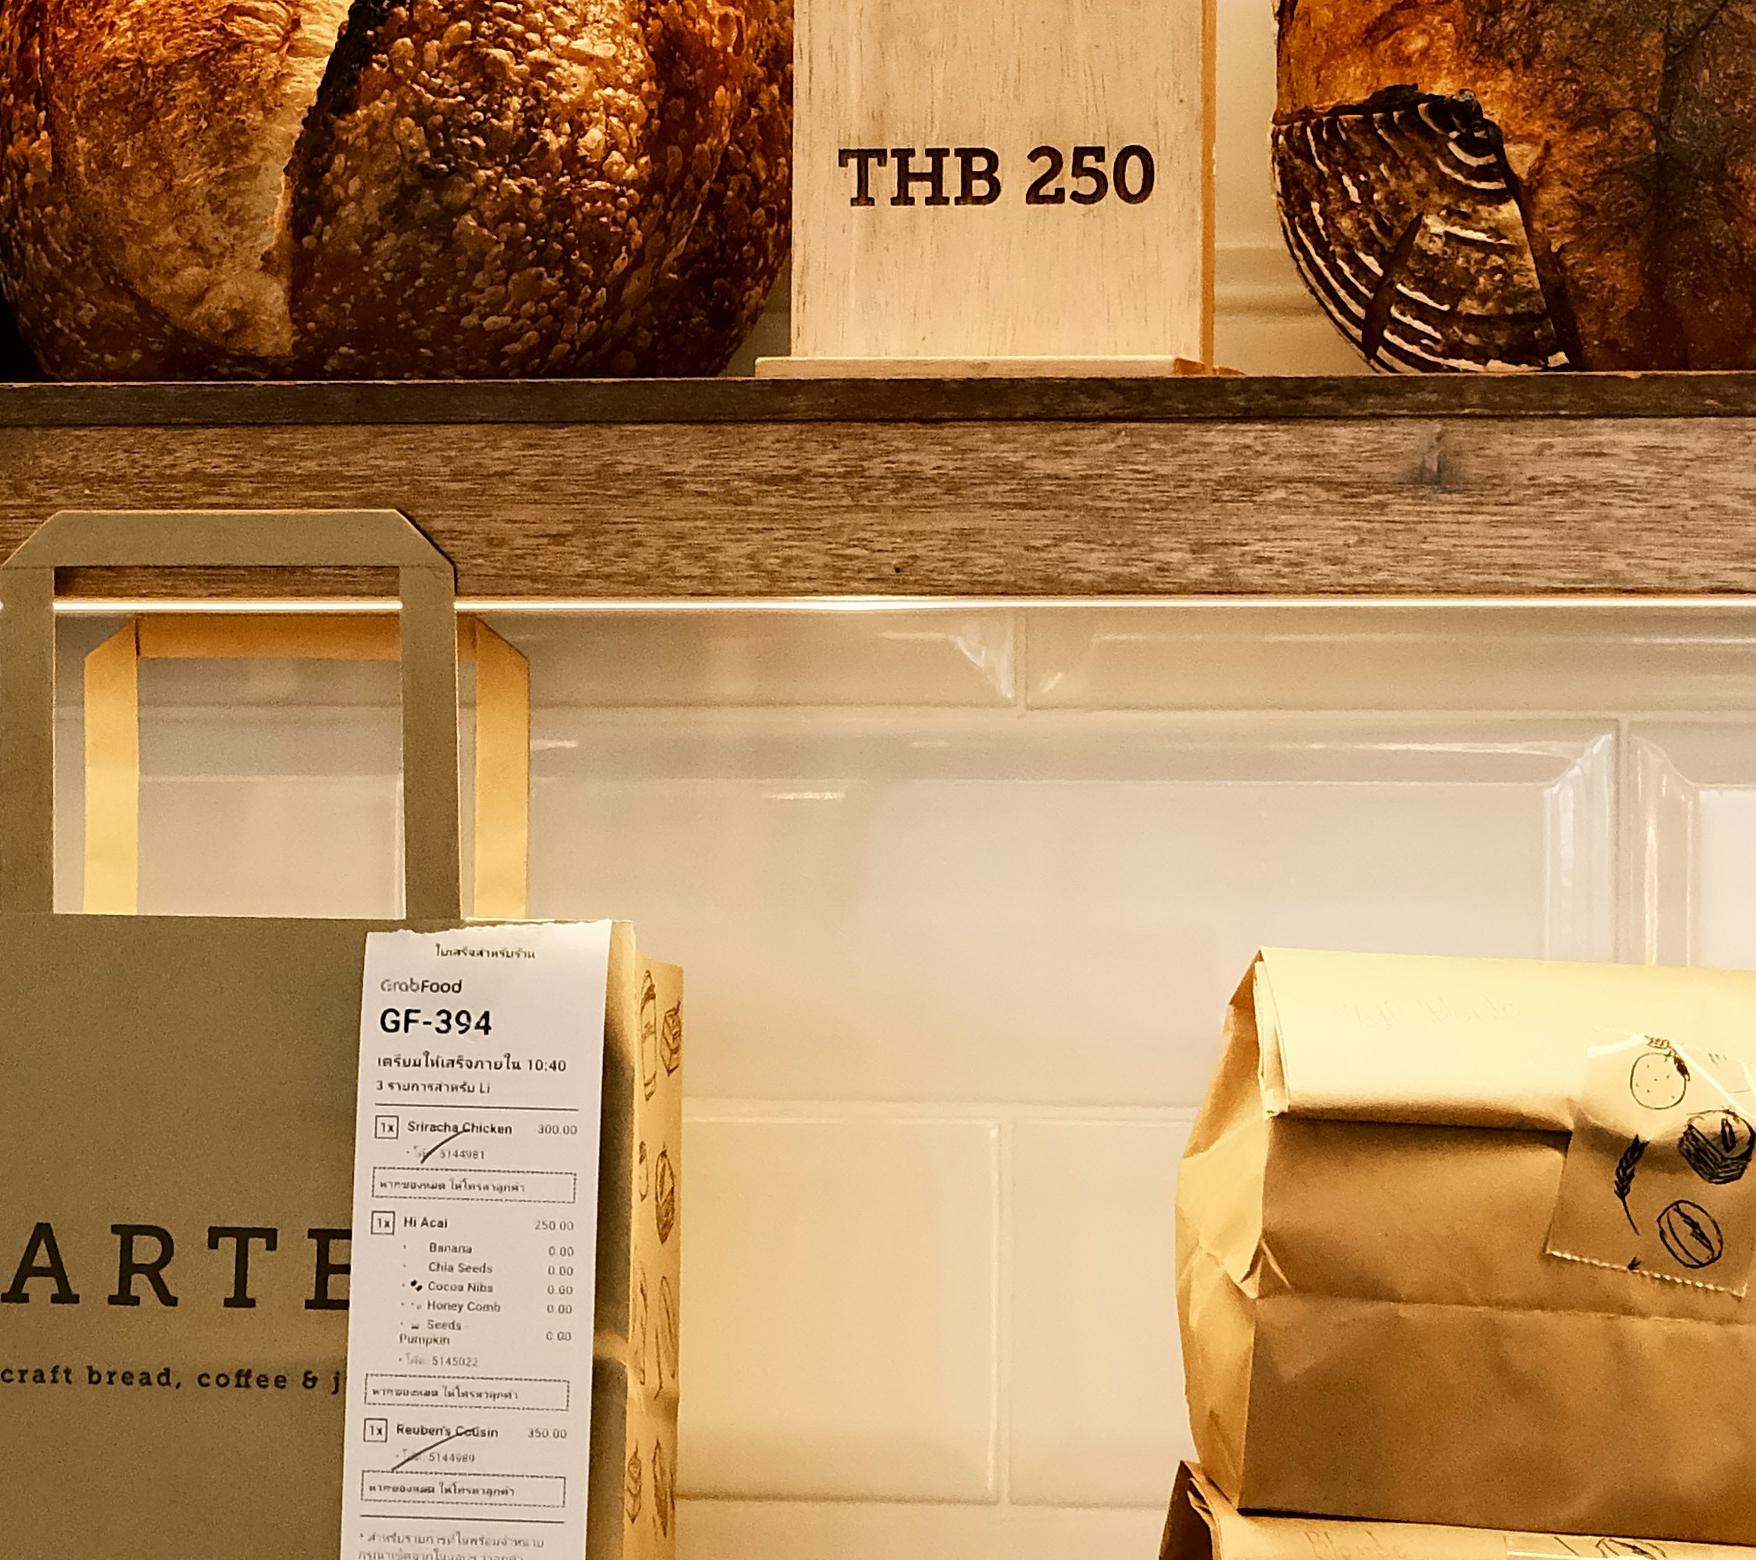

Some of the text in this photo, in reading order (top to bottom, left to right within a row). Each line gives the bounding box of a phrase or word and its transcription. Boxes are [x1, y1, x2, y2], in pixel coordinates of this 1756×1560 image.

[837, 144, 1156, 207] THB 250
[380, 978, 463, 994] GrabFood
[380, 1008, 492, 1036] GF-394
[377, 1050, 567, 1072] เตรียมให้เสร็จภายใน 10:40
[376, 1081, 383, 1091] 3
[380, 1120, 578, 1135] 1x Sriracha Chicken 300.00
[376, 1216, 574, 1231] 1x Hi Acai 250.00
[429, 1242, 574, 1257] Banana 0.00
[428, 1261, 574, 1276] Chia Seeds 0.00
[428, 1281, 574, 1295] Cocoa Nibs 0.00
[427, 1300, 573, 1315] Honey Comb 0.00
[427, 1319, 462, 1331] Seeds
[399, 1333, 451, 1348] Pumpkin
[0, 1365, 74, 1385] craft
[86, 1367, 183, 1390] bread,
[197, 1369, 287, 1390] coffee
[302, 1371, 318, 1390] &
[369, 1423, 568, 1439] 1x Reuben's Cousin 350.00
